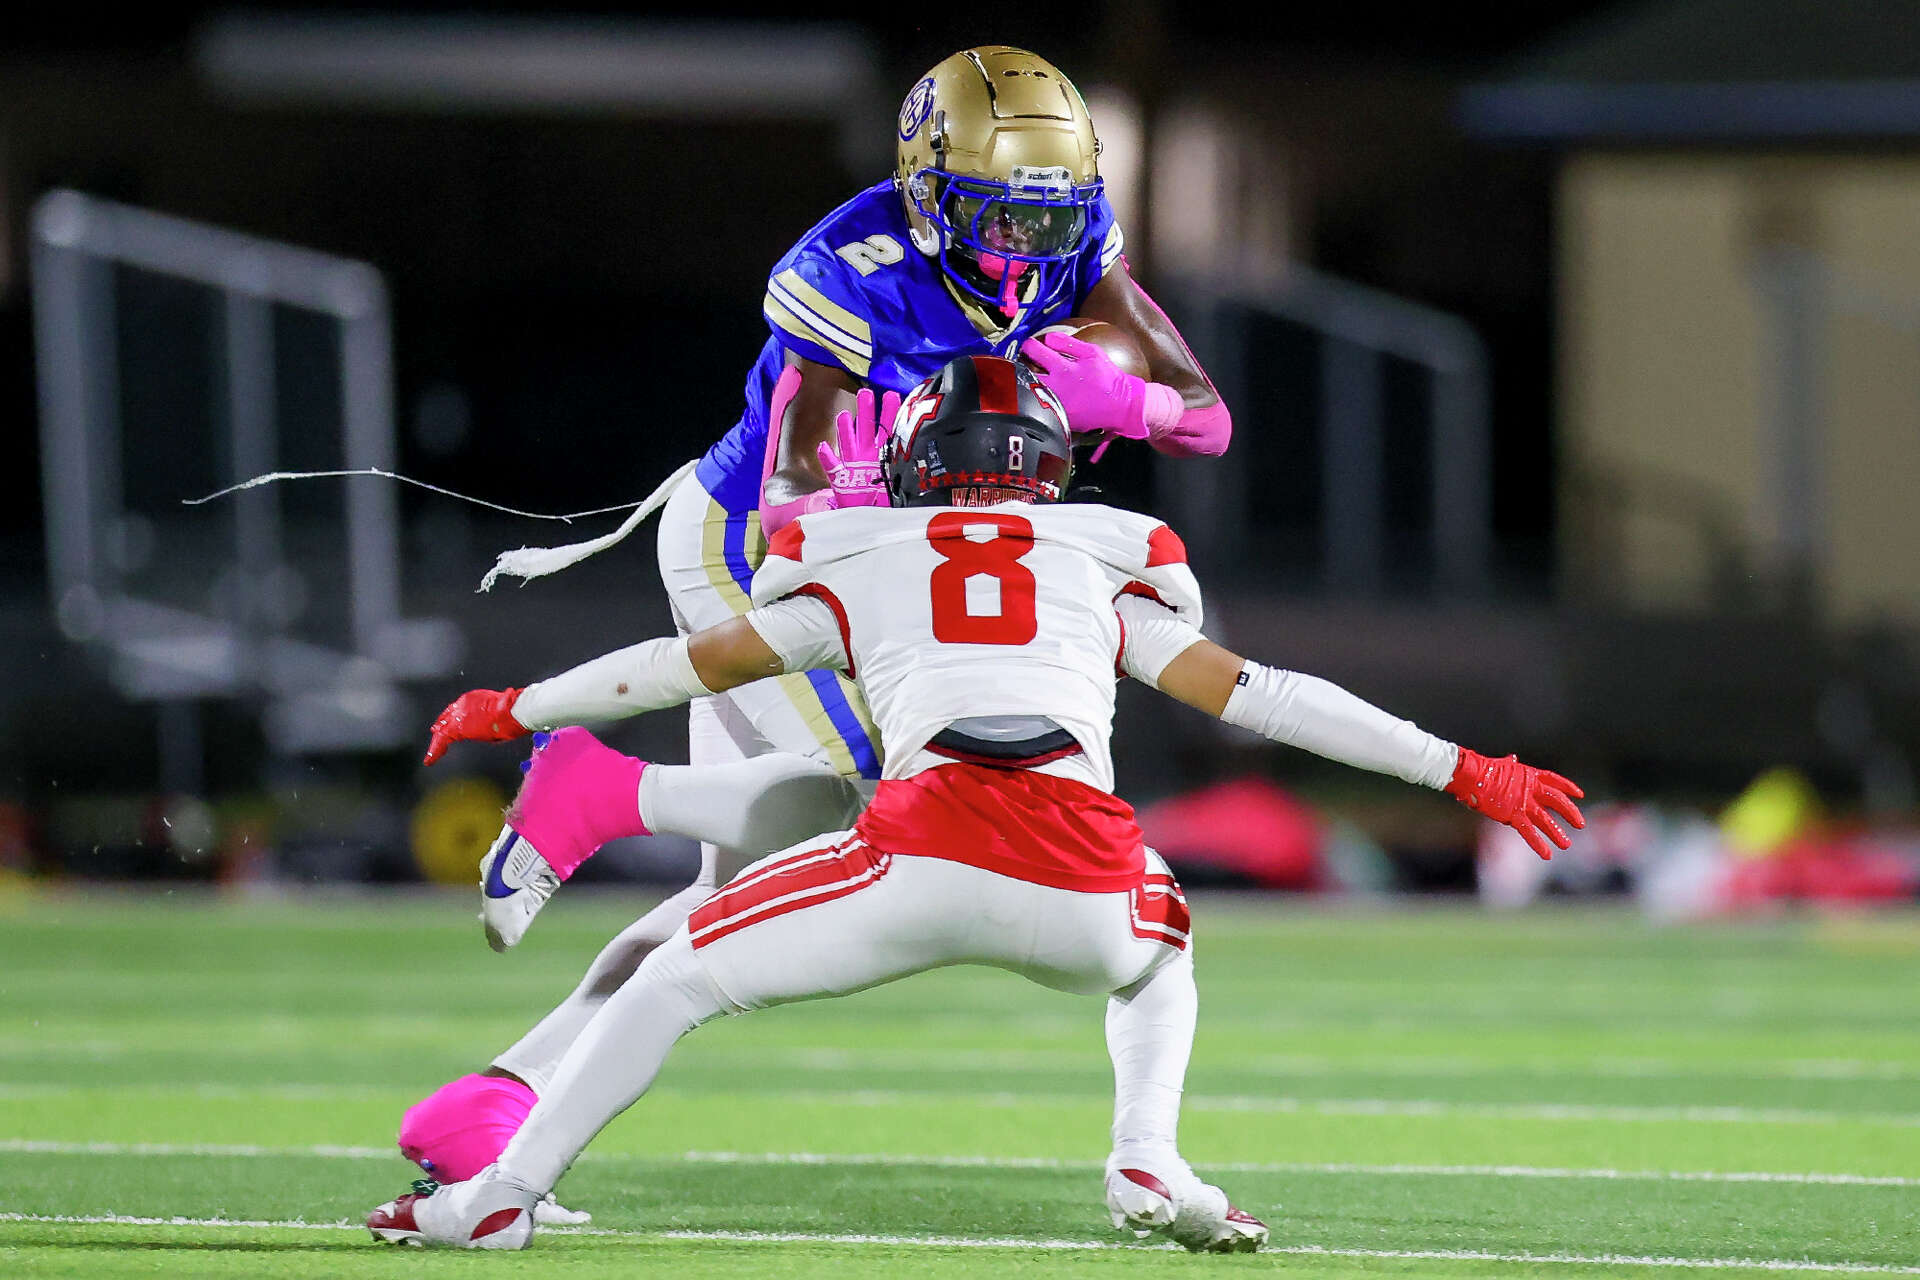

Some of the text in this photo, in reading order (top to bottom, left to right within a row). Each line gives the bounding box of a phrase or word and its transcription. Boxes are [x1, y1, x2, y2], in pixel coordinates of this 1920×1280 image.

[834, 234, 904, 277] 2
[1008, 435, 1024, 471] 8
[926, 511, 1038, 645] 8
